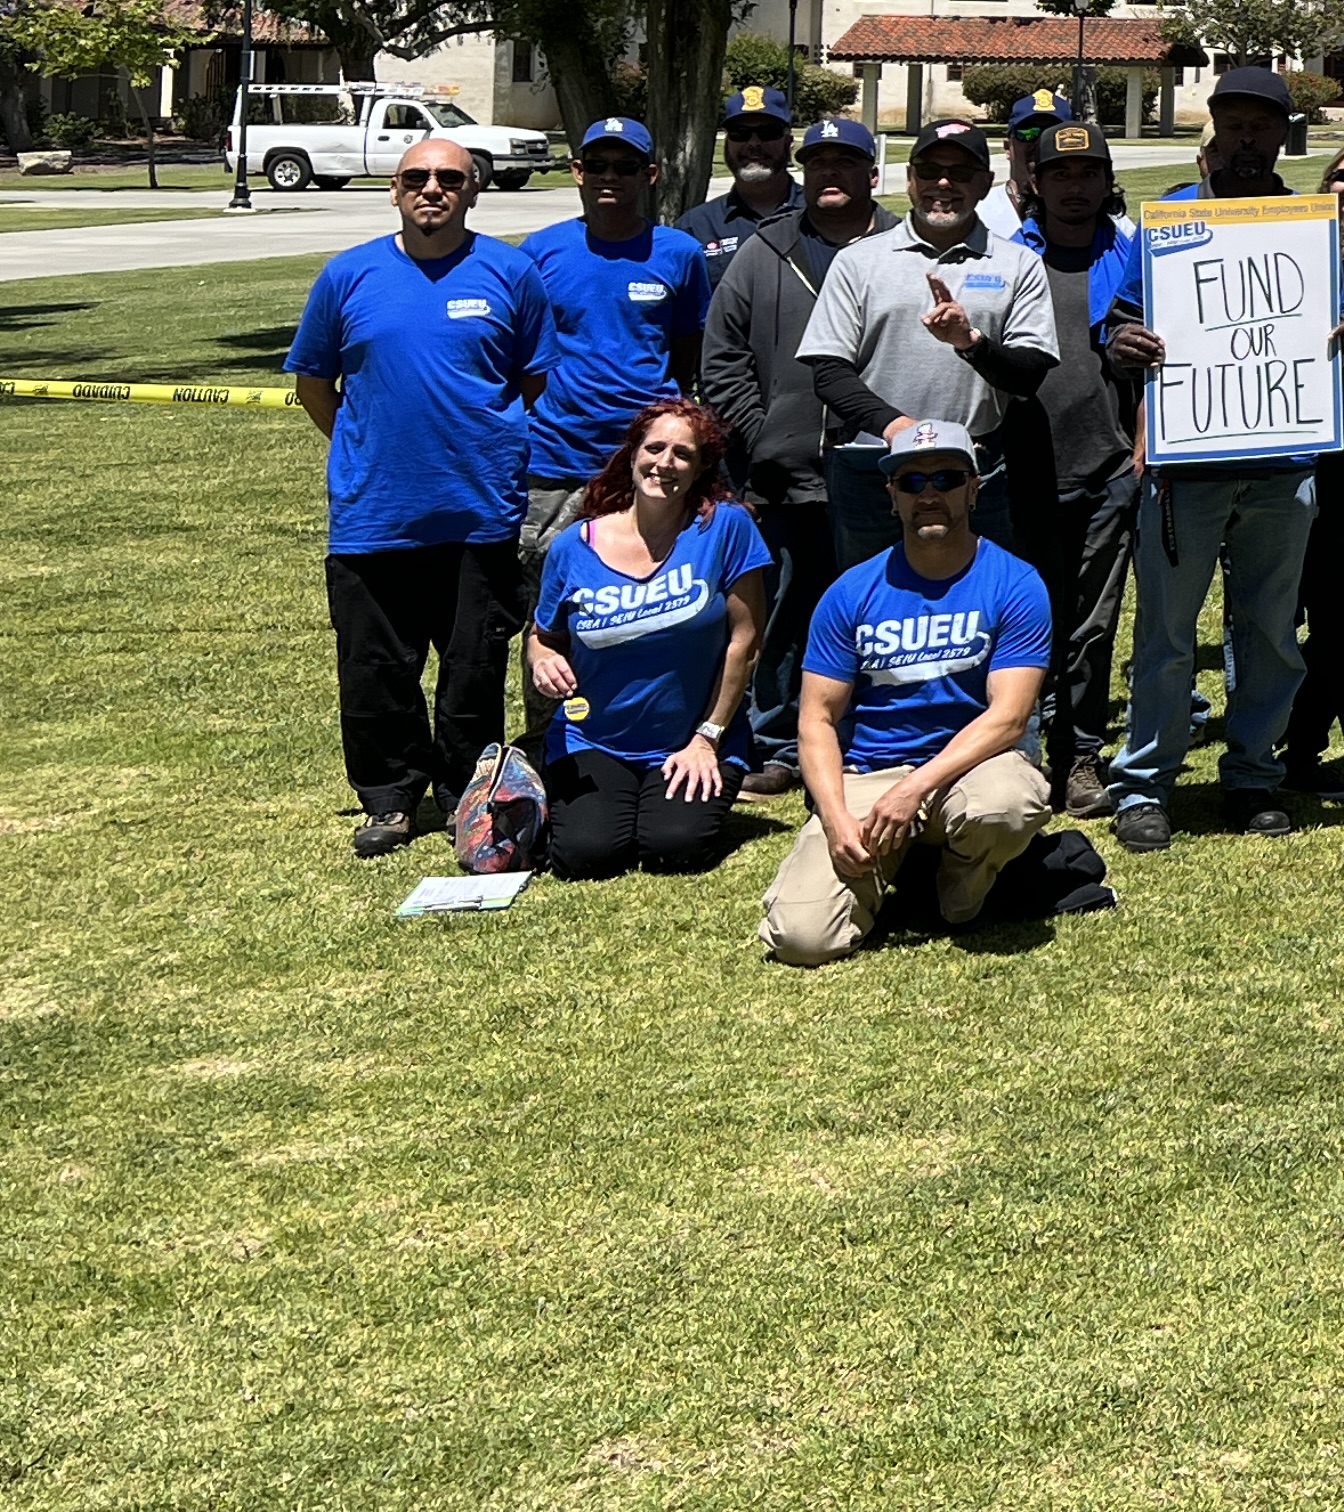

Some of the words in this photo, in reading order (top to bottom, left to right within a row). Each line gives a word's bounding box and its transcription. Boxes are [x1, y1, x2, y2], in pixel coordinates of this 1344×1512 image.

[821, 120, 838, 138] LA
[1144, 207, 1187, 220] California
[1189, 207, 1213, 218] State
[1215, 206, 1260, 218] University
[1262, 204, 1309, 216] Employees
[1311, 202, 1336, 213] Union
[1149, 221, 1206, 243] CSUEU
[1193, 252, 1304, 324] FUND
[1231, 324, 1277, 360] OUR
[1159, 359, 1323, 440] FUTURE
[572, 563, 694, 617] CSUEU
[609, 610, 636, 626] SEIU
[637, 602, 663, 619] Local
[665, 595, 691, 611] 2579
[856, 610, 981, 657] CSUEU
[888, 653, 917, 667] SEIU
[917, 649, 942, 662] Local
[941, 646, 971, 659] 2579
